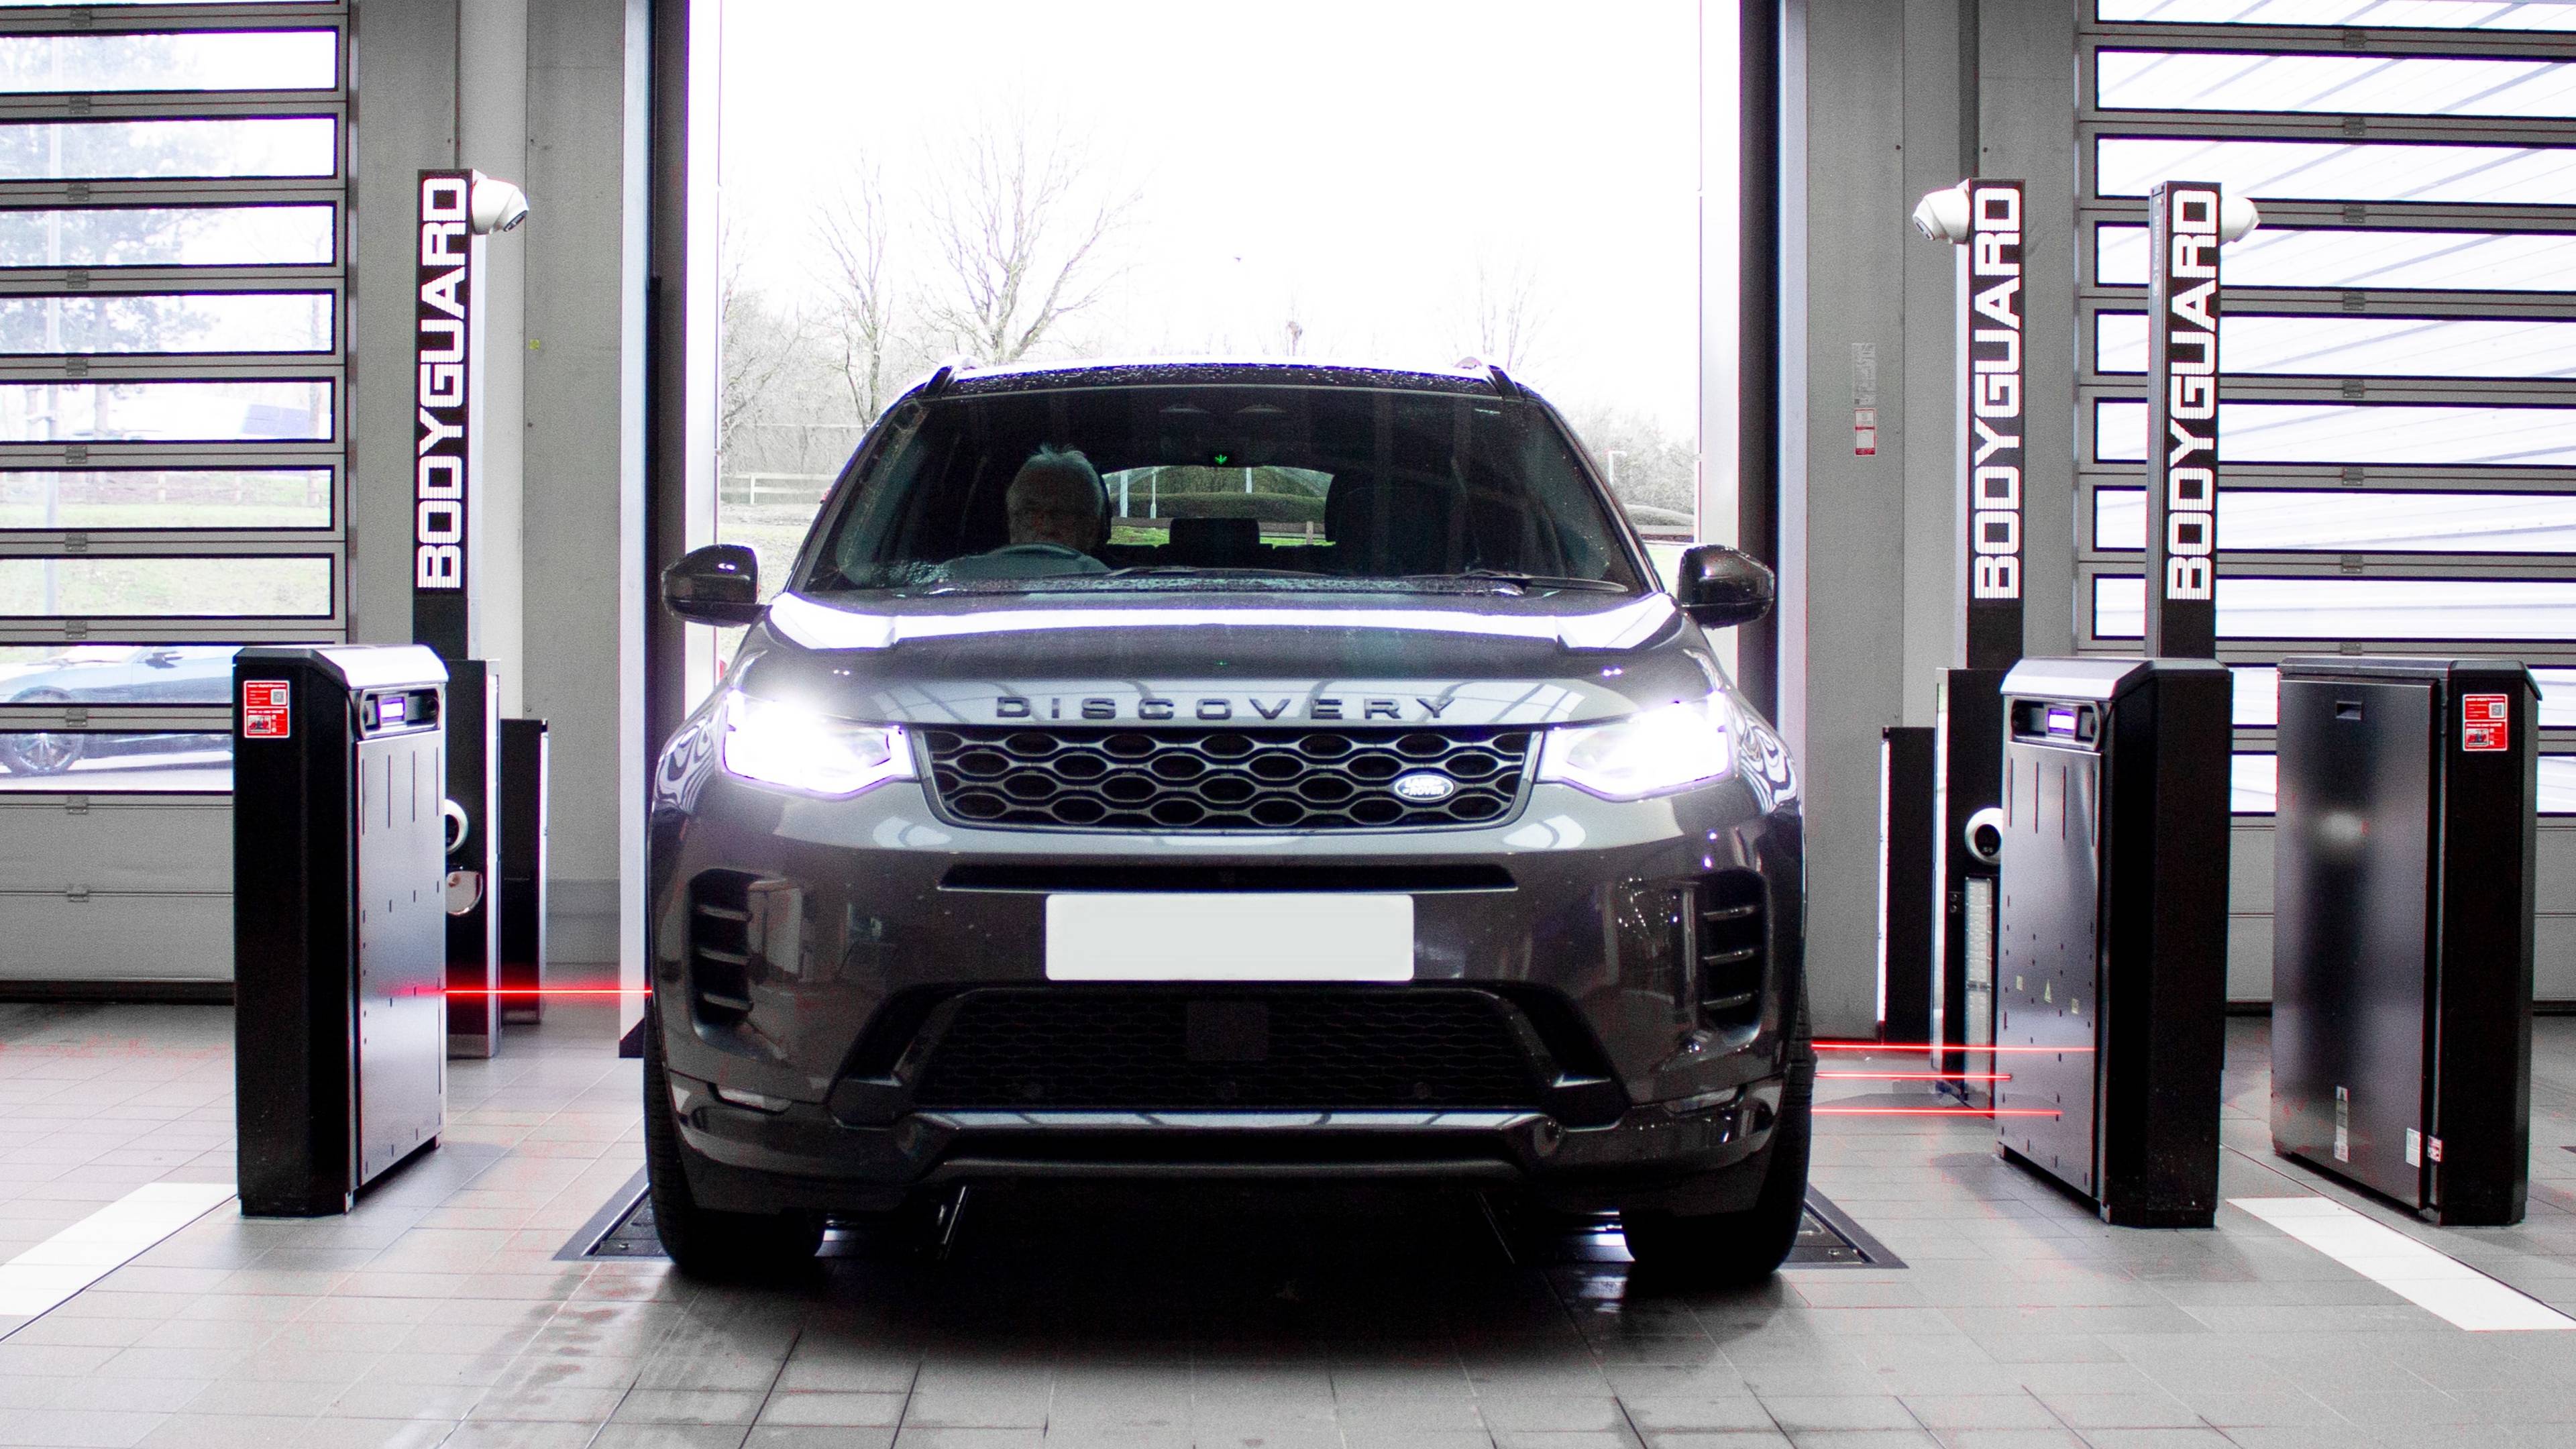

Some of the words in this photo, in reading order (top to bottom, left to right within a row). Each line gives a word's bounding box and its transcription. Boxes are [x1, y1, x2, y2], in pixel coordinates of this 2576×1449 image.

[419, 177, 468, 589] BODYGUARD
[1974, 187, 2021, 600] BODYGUARD
[2166, 189, 2218, 600] BODYGUARD
[996, 696, 1456, 720] DISCOVERY
[1409, 786, 1445, 795] ROVER
